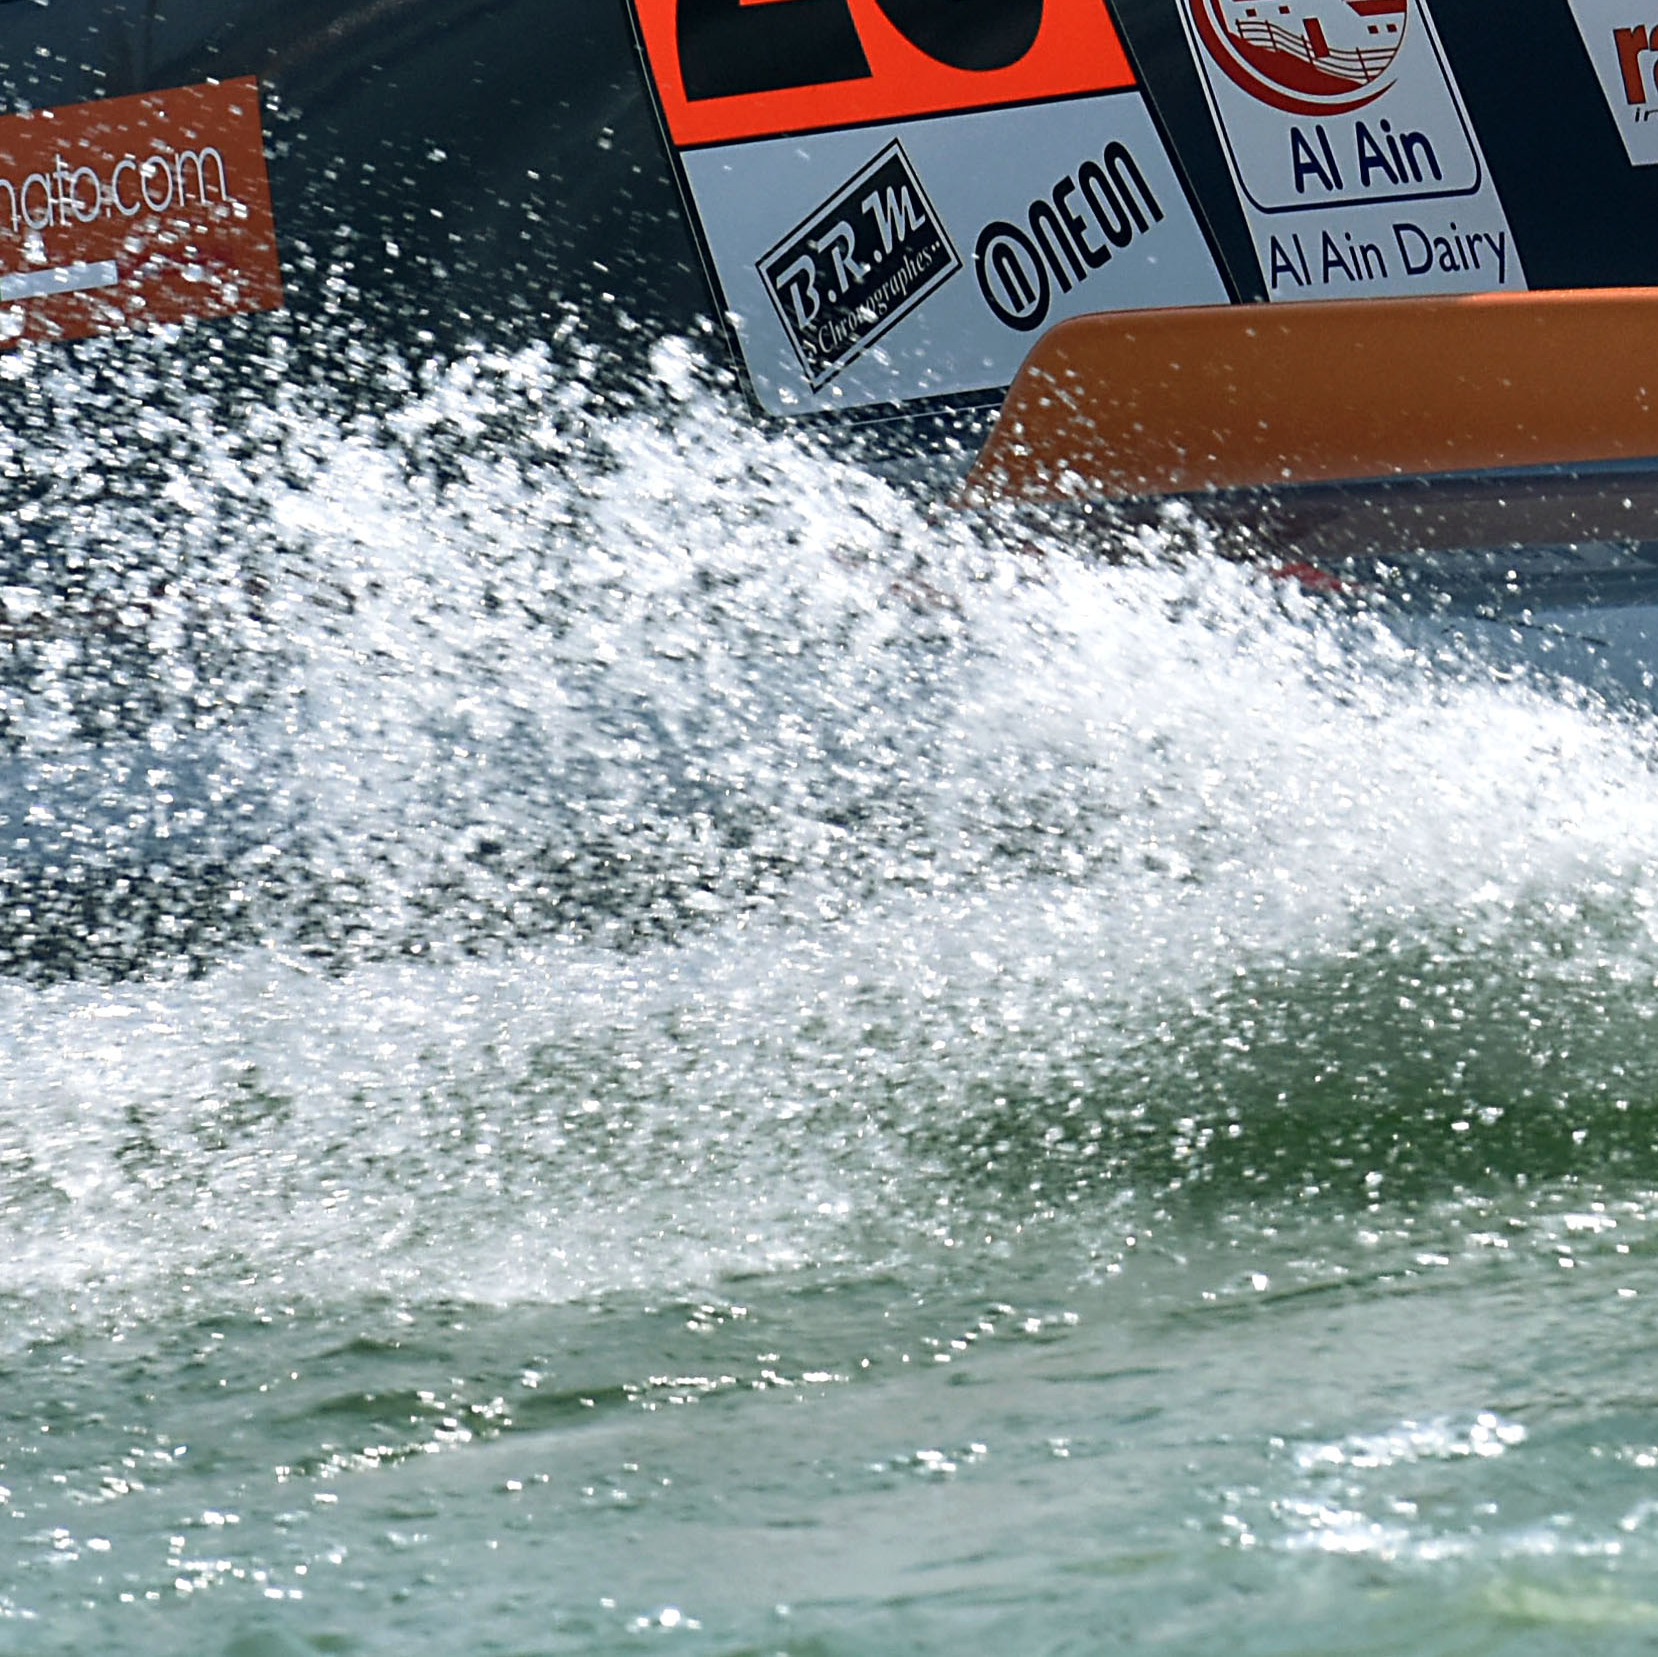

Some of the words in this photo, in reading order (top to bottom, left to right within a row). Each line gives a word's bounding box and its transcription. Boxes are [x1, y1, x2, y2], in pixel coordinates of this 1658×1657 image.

[1290, 123, 1343, 194] Al
[1356, 118, 1443, 188] Ain
[1270, 233, 1311, 290] Al
[1321, 229, 1386, 284] Ain
[1393, 221, 1507, 285] Dairy
